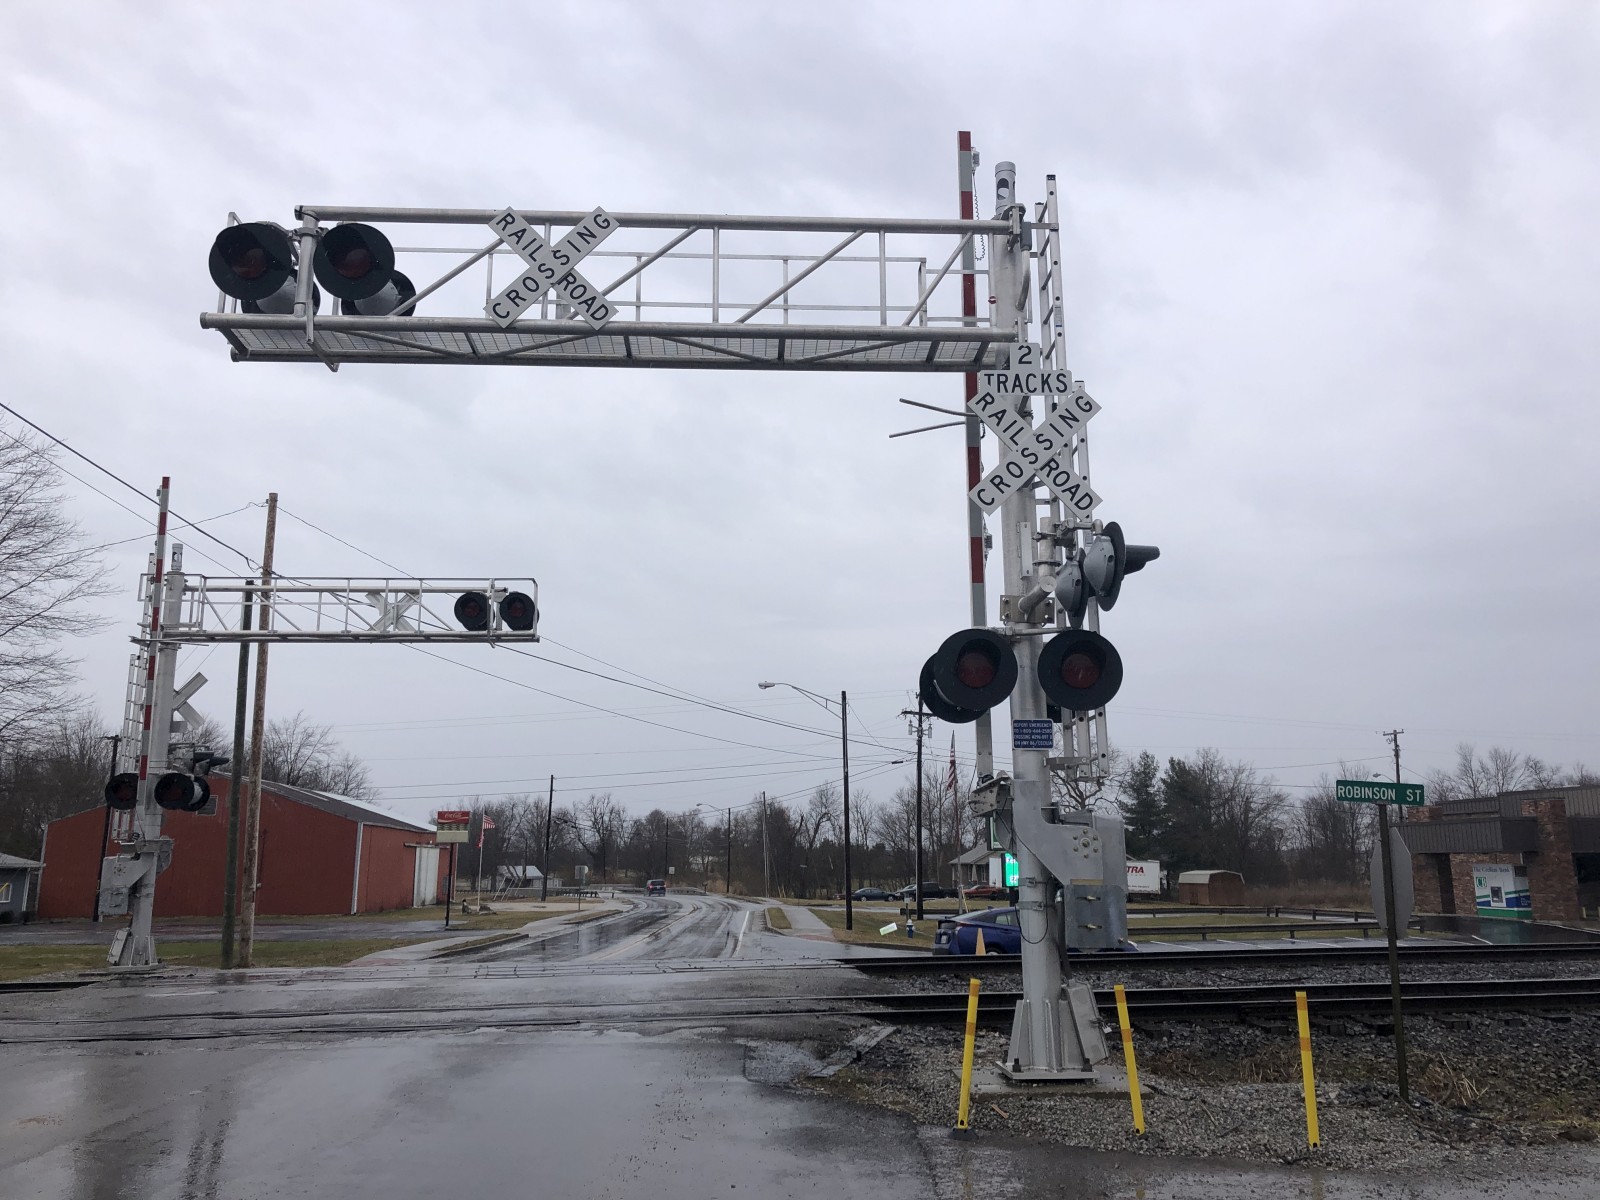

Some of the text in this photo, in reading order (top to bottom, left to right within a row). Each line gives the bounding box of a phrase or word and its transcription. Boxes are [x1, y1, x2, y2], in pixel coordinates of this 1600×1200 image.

[492, 213, 611, 319] CROSSING
[495, 212, 609, 321] RAIL ROAD
[983, 373, 1068, 394] TRACKS
[1018, 345, 1032, 364] 2
[975, 391, 1093, 511] RAIL ROAD
[976, 395, 1093, 506] CROSSING
[1337, 785, 1421, 802] ROBINSON ST
[1127, 866, 1145, 874] TRA
